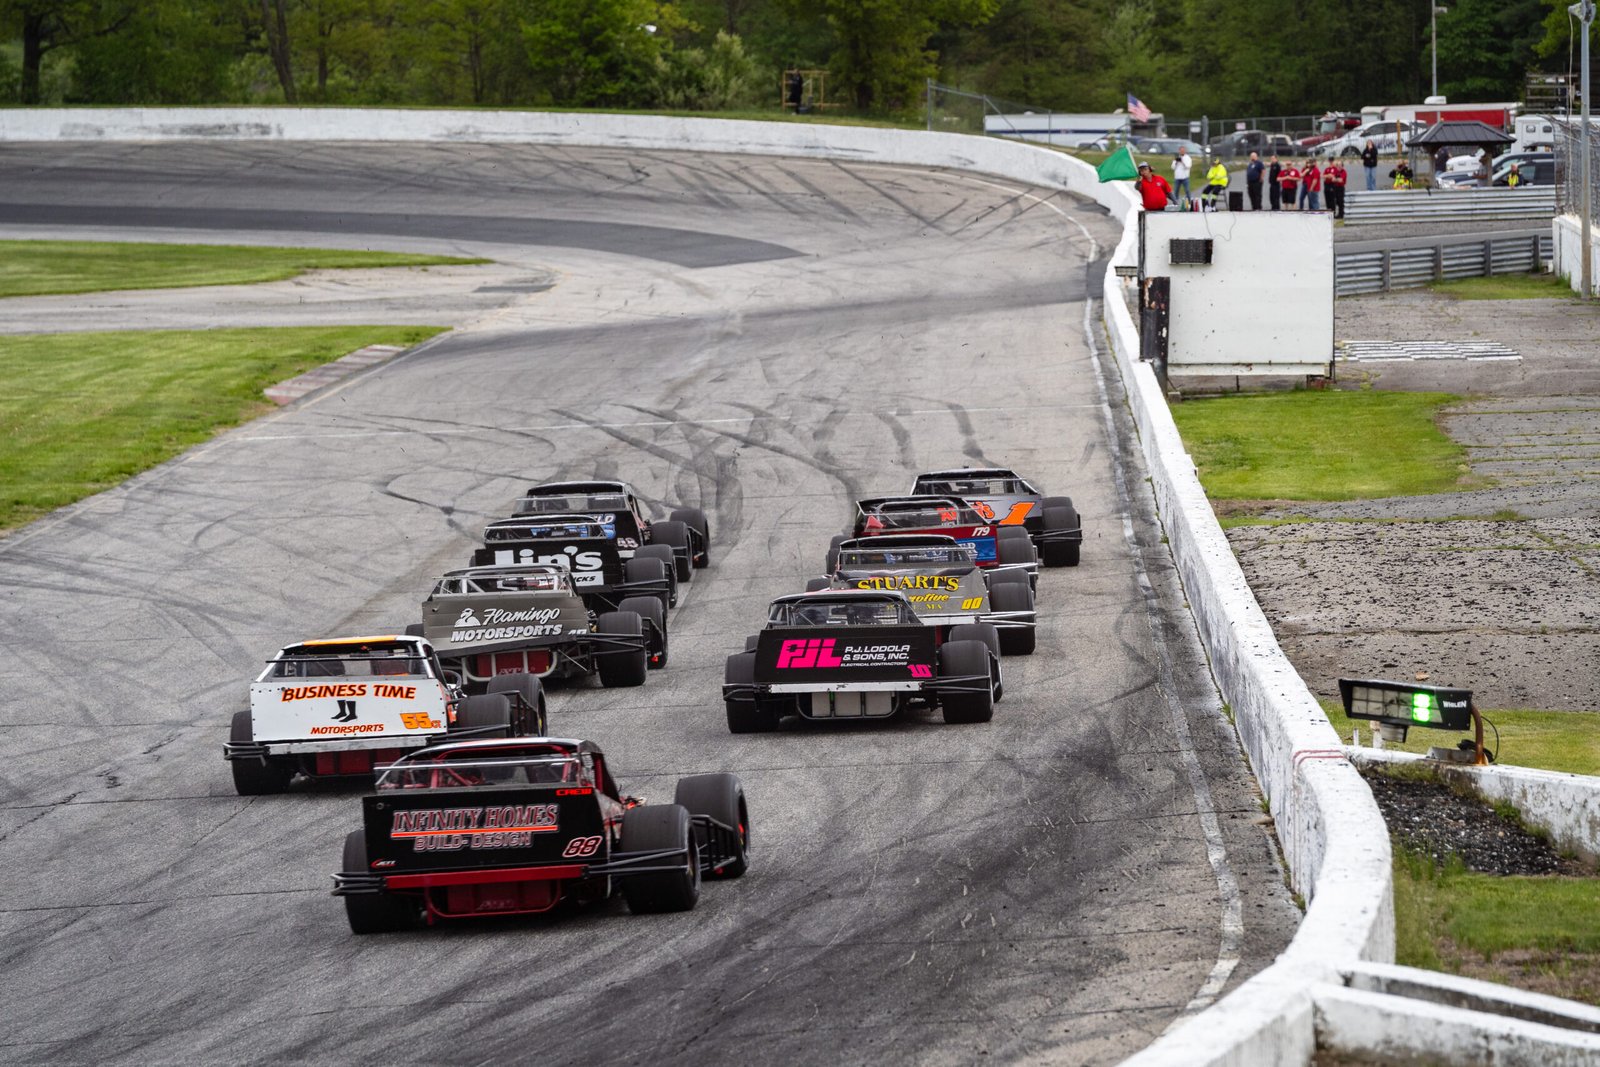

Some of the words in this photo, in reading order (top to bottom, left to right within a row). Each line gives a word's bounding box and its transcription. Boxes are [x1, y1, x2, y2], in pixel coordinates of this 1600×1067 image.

[998, 502, 1036, 525] 1
[857, 575, 960, 592] STUART'S
[961, 597, 983, 610] 00
[482, 607, 560, 625] Flamingo
[450, 624, 563, 642] MOTORSPORTS
[776, 638, 842, 669] PJL
[842, 653, 852, 661] &
[852, 653, 887, 662] SONS,
[887, 652, 910, 660] INC.
[864, 644, 911, 653] LODOLA
[281, 684, 367, 702] BUSINESS
[373, 684, 417, 699] TIME
[310, 724, 384, 735] MOTORSPORTS
[391, 807, 484, 832] INFINITY
[484, 804, 559, 828] HOMES
[470, 831, 533, 849] DESIGN
[562, 836, 603, 858] 88
